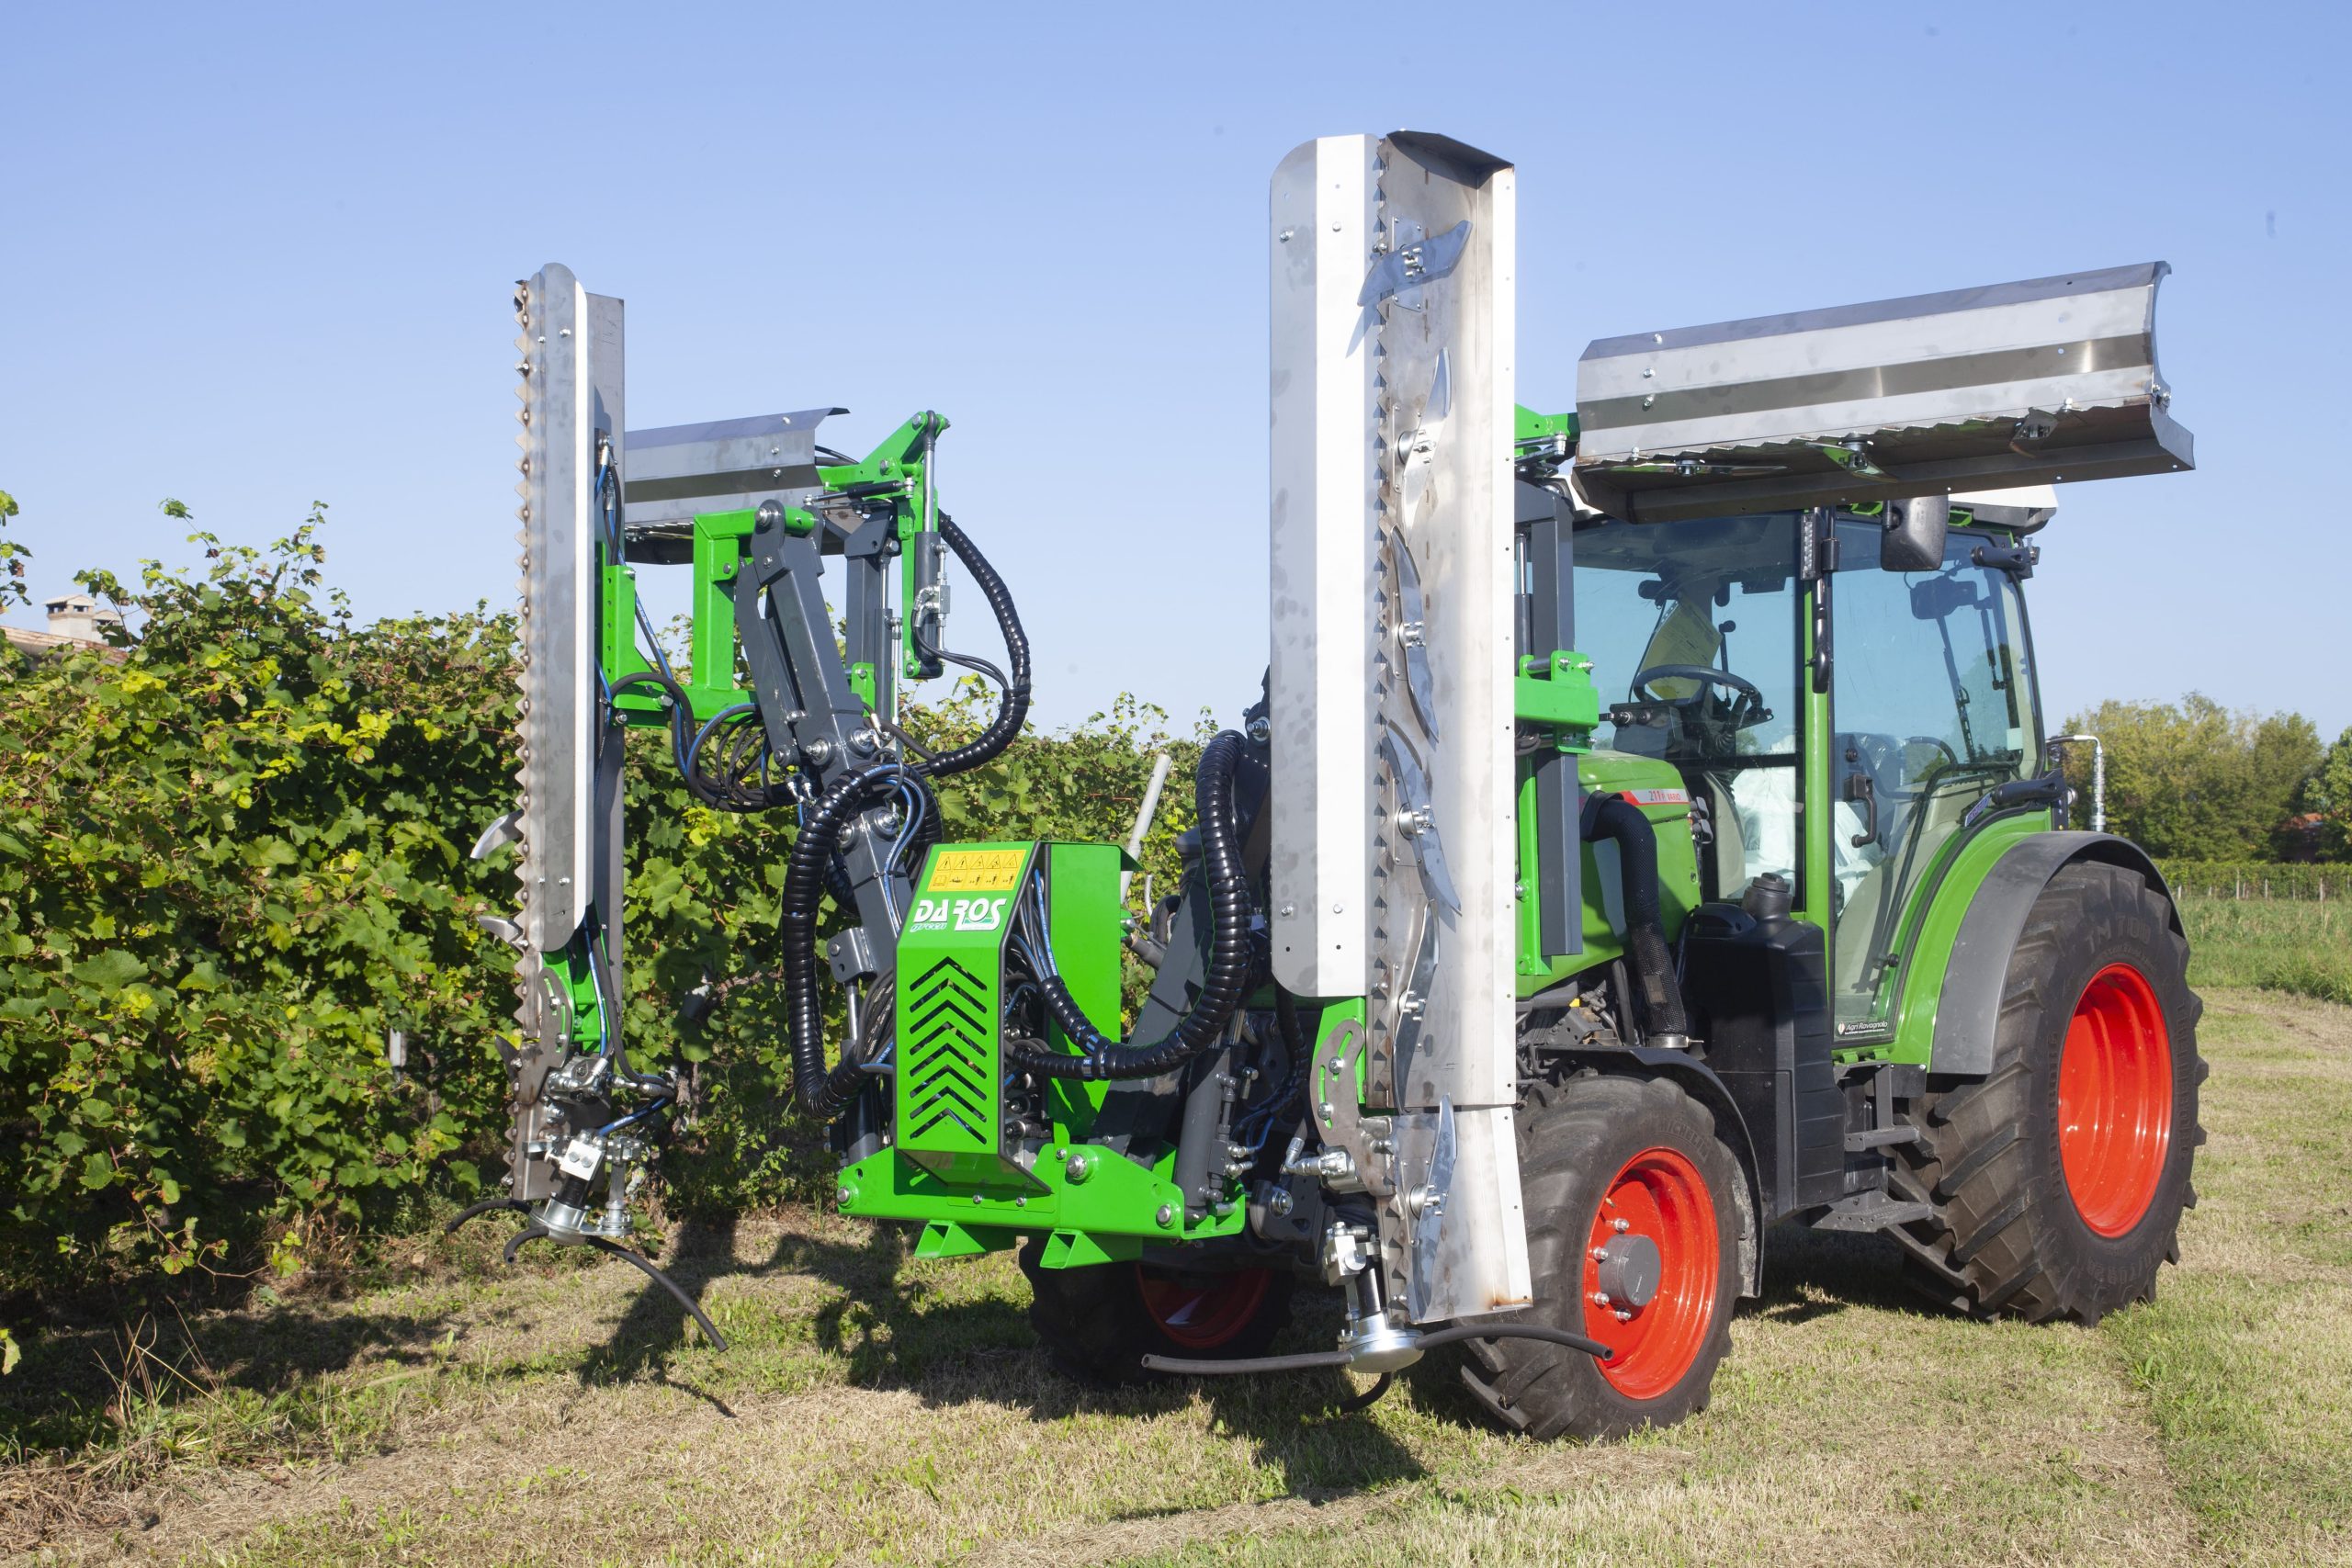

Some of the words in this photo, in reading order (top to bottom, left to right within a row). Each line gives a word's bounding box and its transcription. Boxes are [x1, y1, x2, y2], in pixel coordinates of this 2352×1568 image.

[1666, 793, 1681, 801] VARIO
[913, 899, 949, 923] DA
[953, 897, 1007, 931] ROS
[909, 922, 947, 932] green
